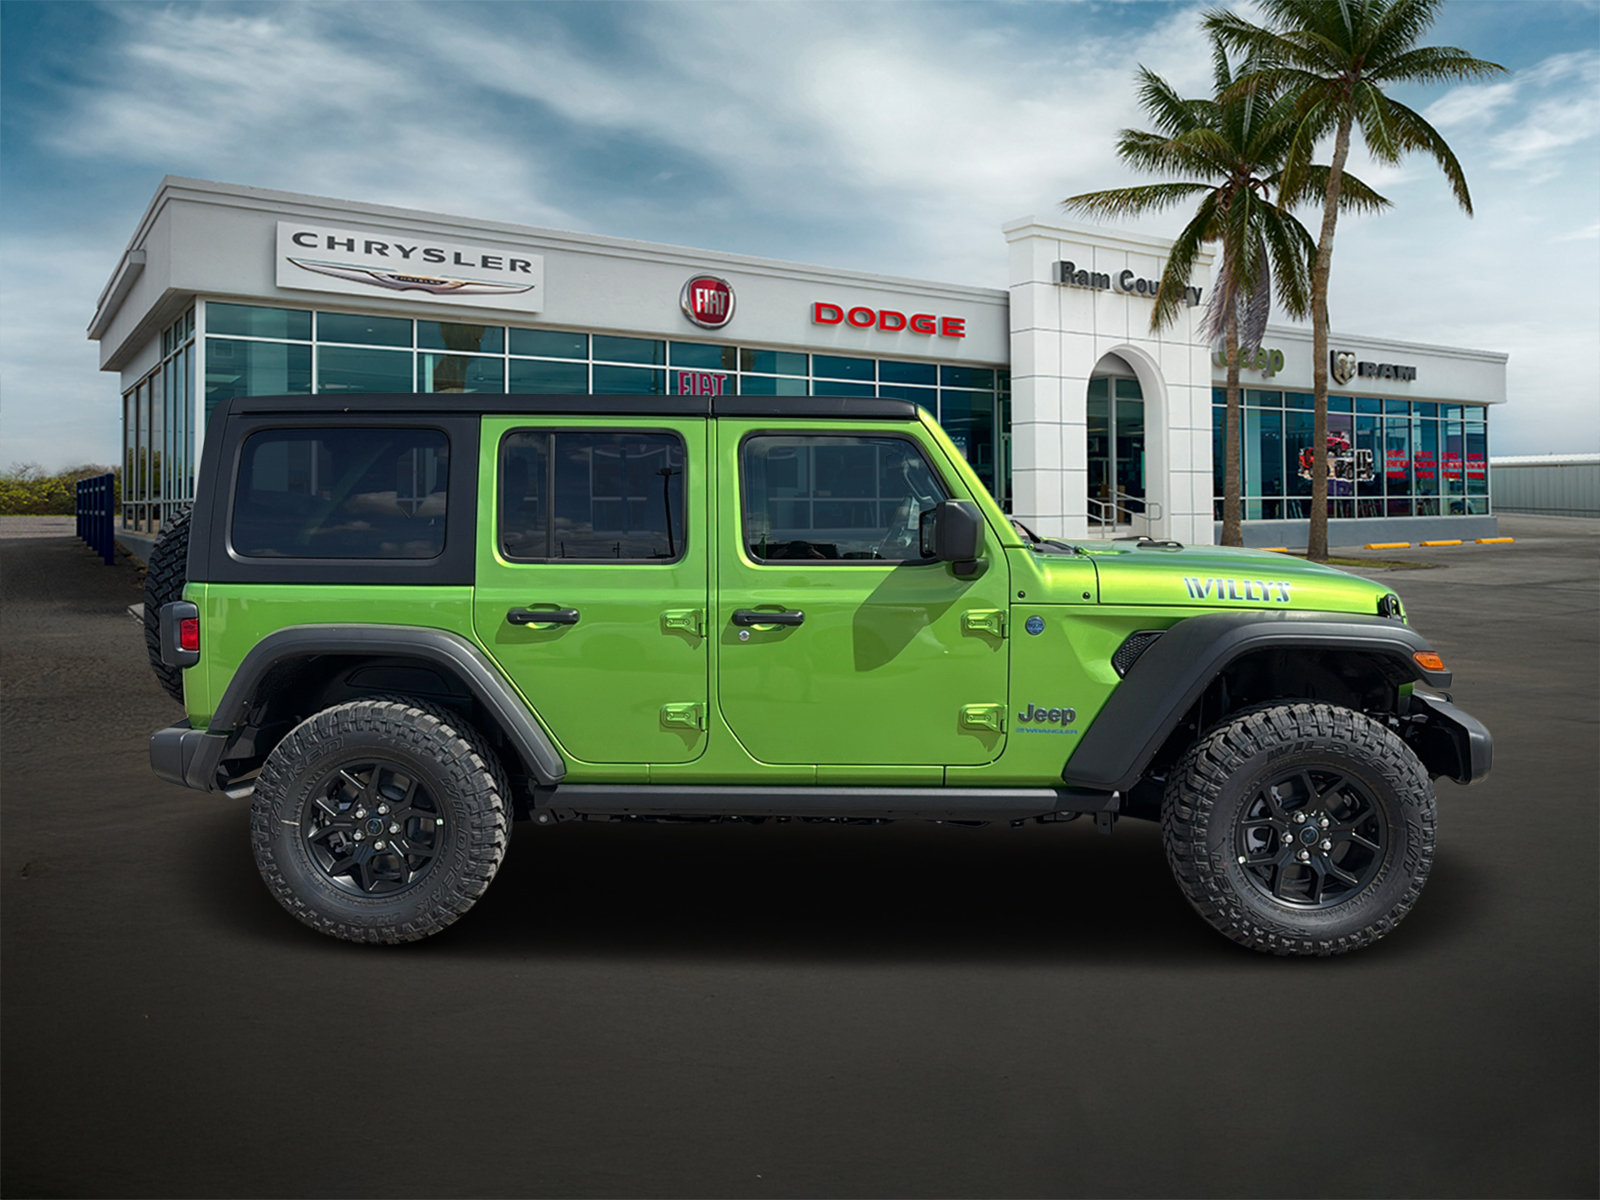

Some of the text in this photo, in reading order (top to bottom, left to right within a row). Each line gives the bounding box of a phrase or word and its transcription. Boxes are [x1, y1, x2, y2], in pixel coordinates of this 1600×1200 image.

[292, 232, 532, 274] CHRYSLER
[1054, 261, 1203, 306] Ram Coury
[695, 287, 728, 316] FIAT
[812, 301, 966, 338] DODGE
[678, 371, 727, 395] FIAT
[1358, 361, 1417, 381] RAM
[1184, 577, 1290, 602] WILLYS
[1018, 702, 1076, 727] Jeep
